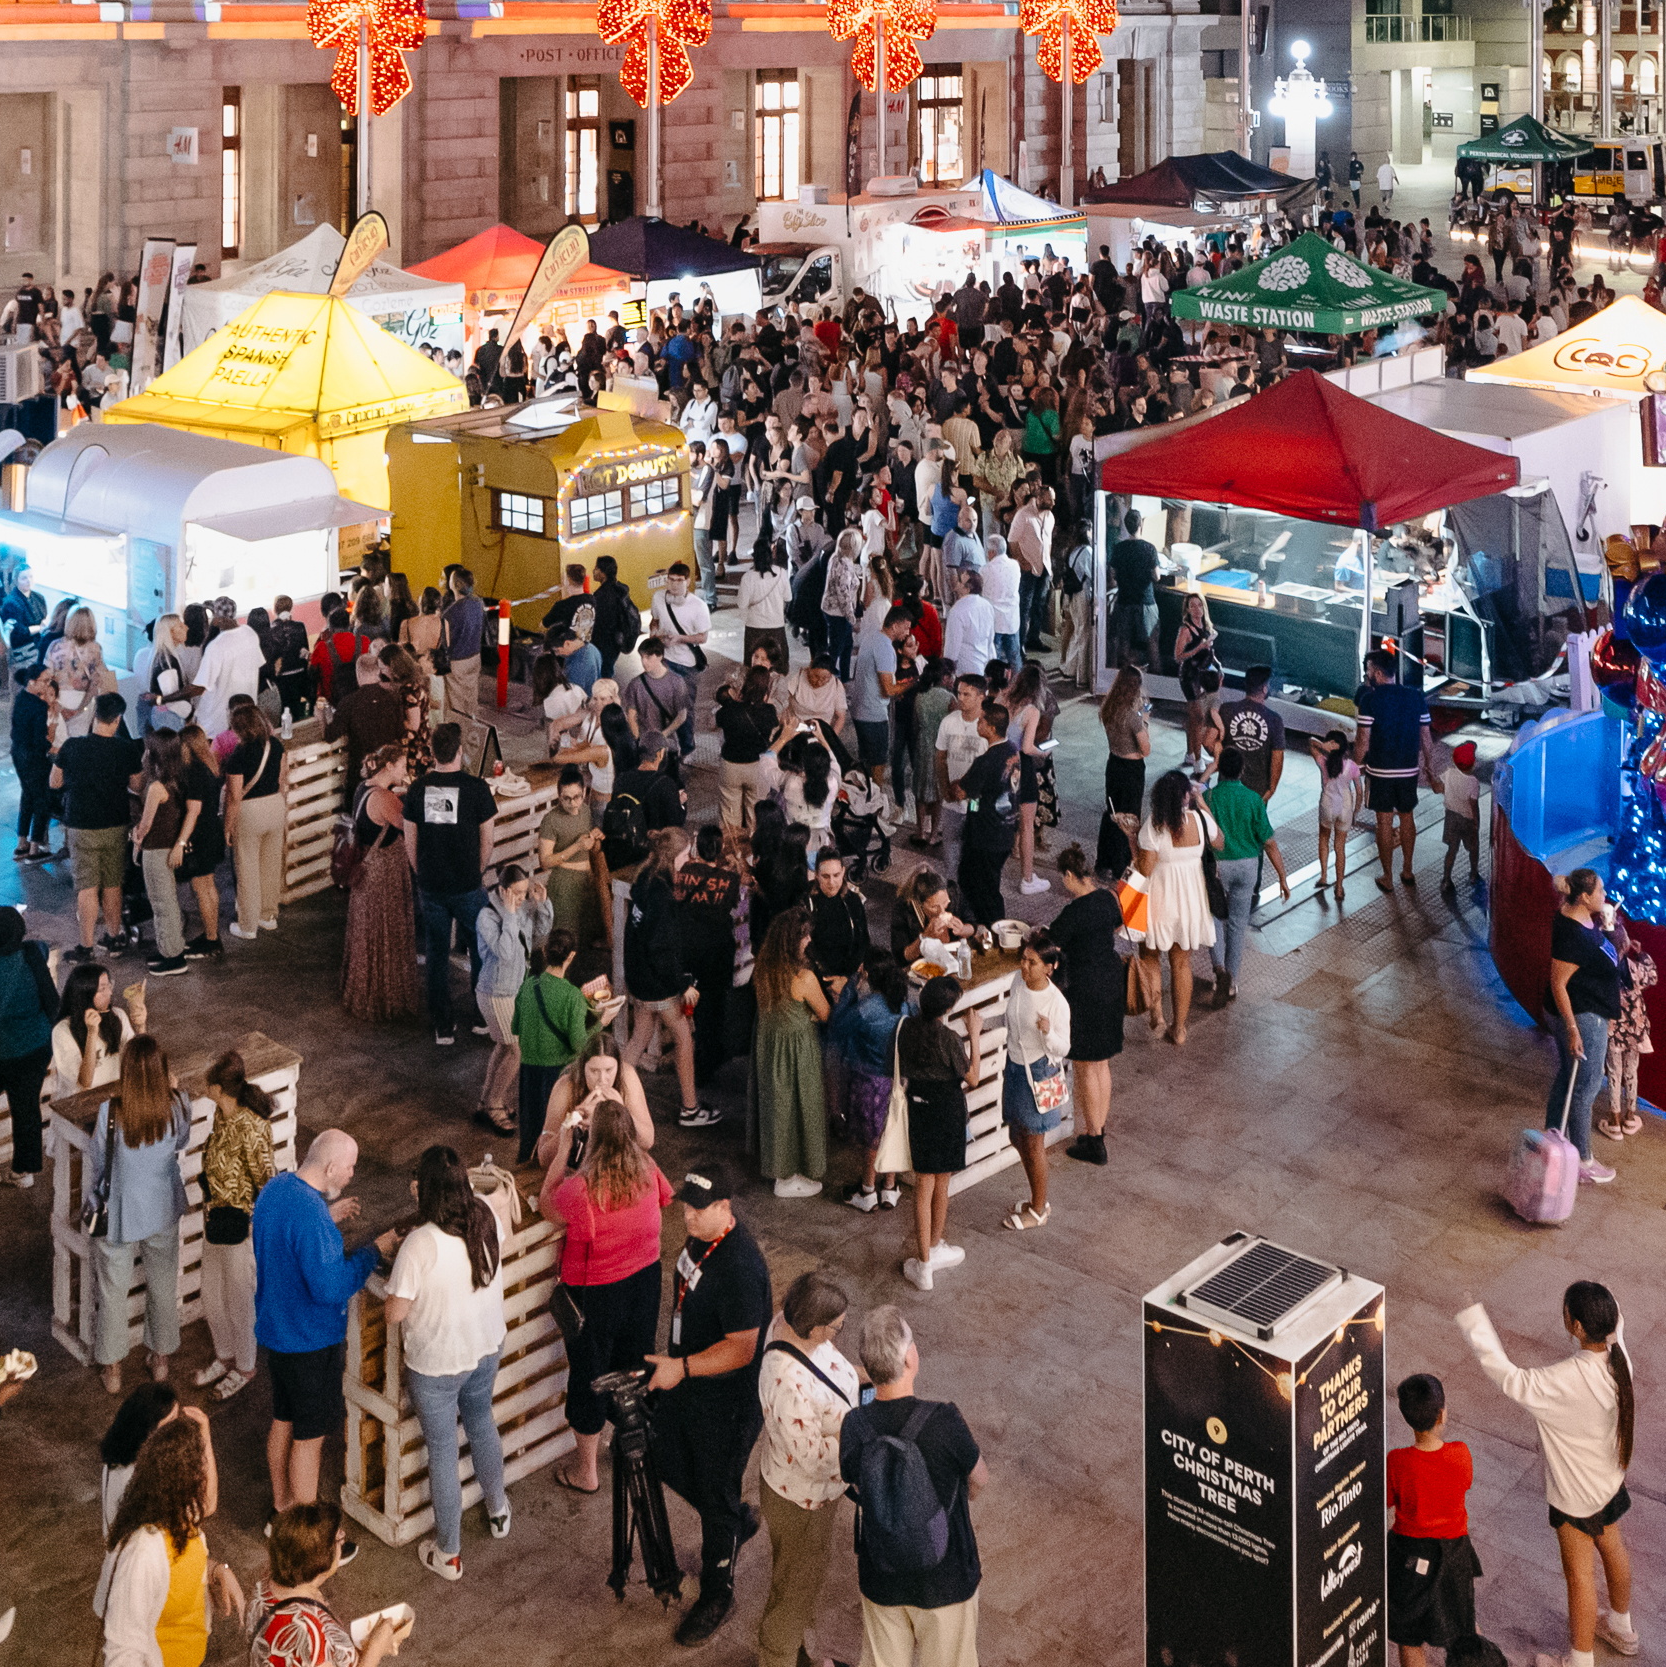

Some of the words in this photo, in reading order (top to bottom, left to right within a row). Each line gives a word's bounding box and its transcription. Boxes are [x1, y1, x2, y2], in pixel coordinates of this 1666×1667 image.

[526, 48, 563, 62] POST
[577, 47, 623, 61] OFFICE
[1509, 152, 1544, 160] VOLUNTEERS
[1199, 300, 1250, 323] WASTE
[1252, 306, 1315, 329] STATION
[1360, 305, 1393, 328] WASTE
[1393, 297, 1433, 320] STATION
[227, 323, 316, 345] AUTHENTIC
[223, 344, 293, 366] SPANISH
[211, 366, 271, 388] PAELLA
[615, 454, 677, 486] DONUTS
[1318, 1353, 1363, 1403] THANKS
[1319, 1398, 1336, 1423] TO
[1338, 1375, 1362, 1408] OUR
[1213, 1424, 1221, 1436] 9
[1313, 1389, 1369, 1451] PARTNERS
[1160, 1428, 1196, 1457] CITY
[1199, 1446, 1221, 1467] OF
[1224, 1456, 1275, 1495] PERTH
[1173, 1452, 1262, 1507] CHRISTMAS
[1197, 1481, 1237, 1514] TREE
